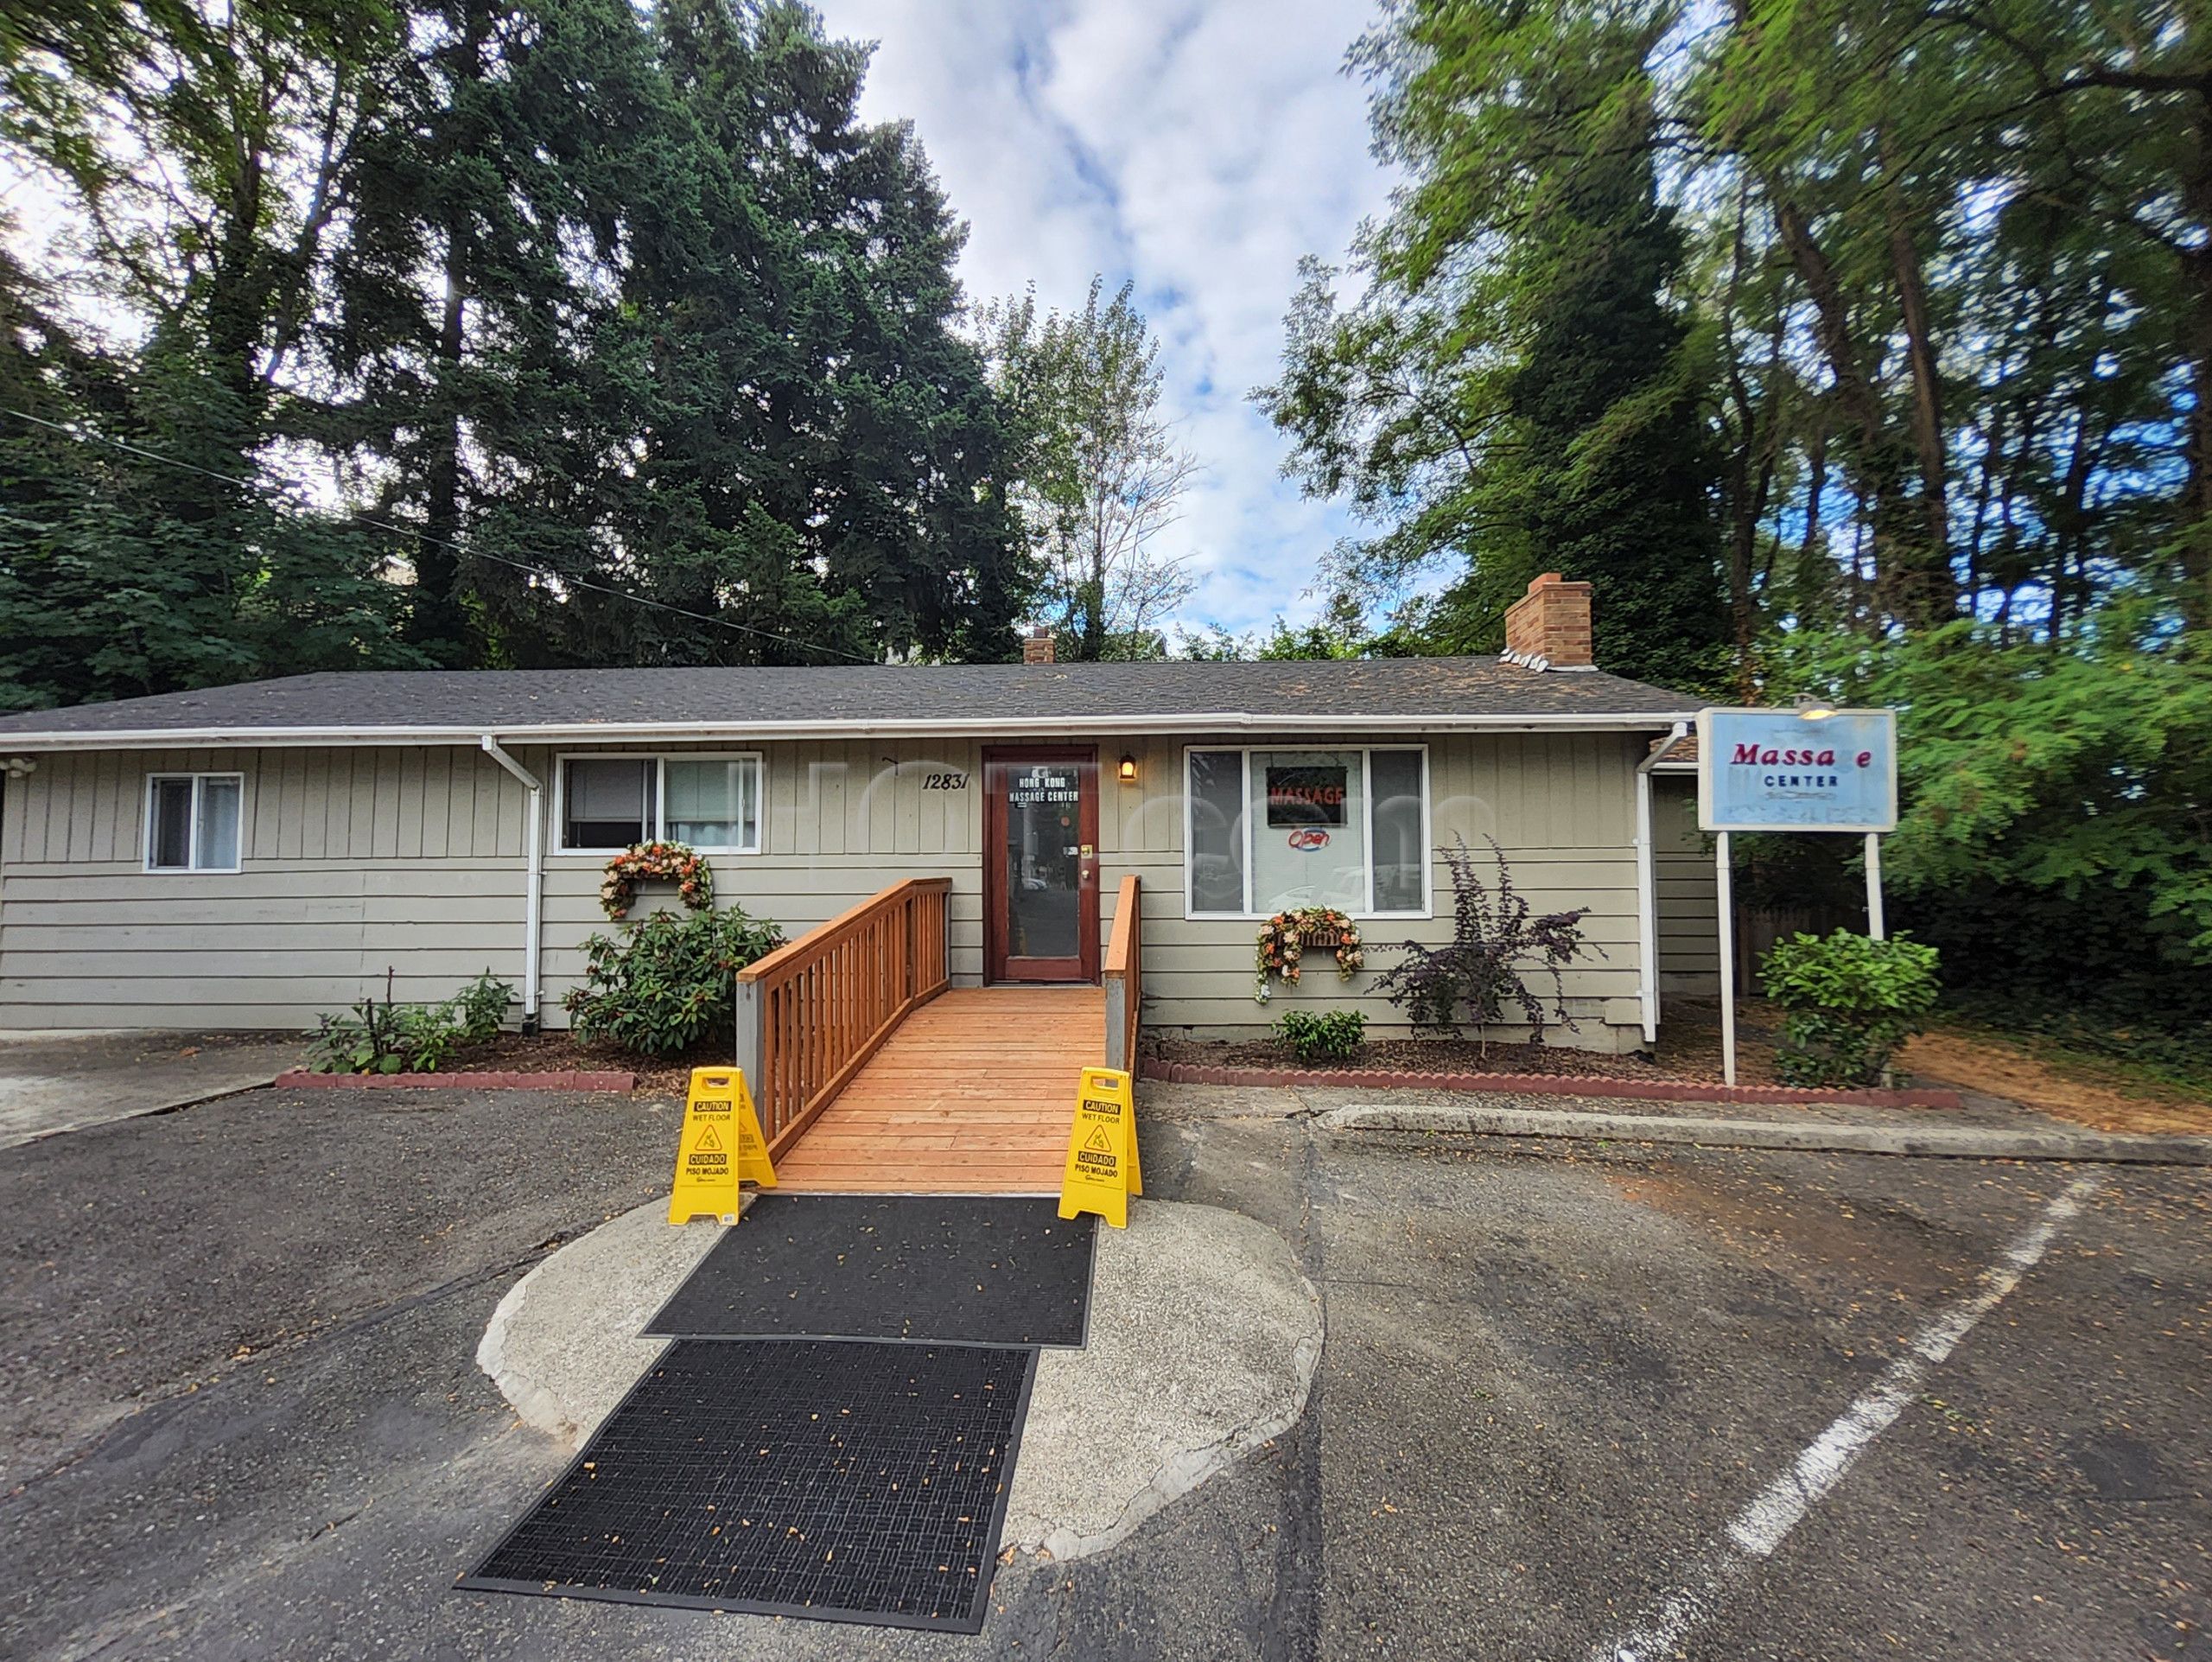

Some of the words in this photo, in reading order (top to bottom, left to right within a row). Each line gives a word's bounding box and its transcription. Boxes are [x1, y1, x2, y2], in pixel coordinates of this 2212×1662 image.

[1730, 743, 1872, 767] Massae
[922, 773, 969, 790] 12831
[1019, 777, 1039, 788] HONG
[1045, 777, 1065, 788] KONG
[1764, 775, 1839, 787] CENTER
[1008, 791, 1045, 802] MASSAGE
[1047, 791, 1078, 802] CENTER
[1270, 786, 1344, 806] MASSAGE
[1288, 831, 1331, 850] Open
[696, 1102, 729, 1111] CAUTION
[1085, 1101, 1119, 1113] CAUTION
[1097, 1115, 1120, 1124] FLOOR
[690, 1154, 725, 1164] CUIDADO
[1079, 1152, 1115, 1166] CUIDADO
[1075, 1164, 1090, 1173] PISO
[1091, 1166, 1118, 1177] MOJADO
